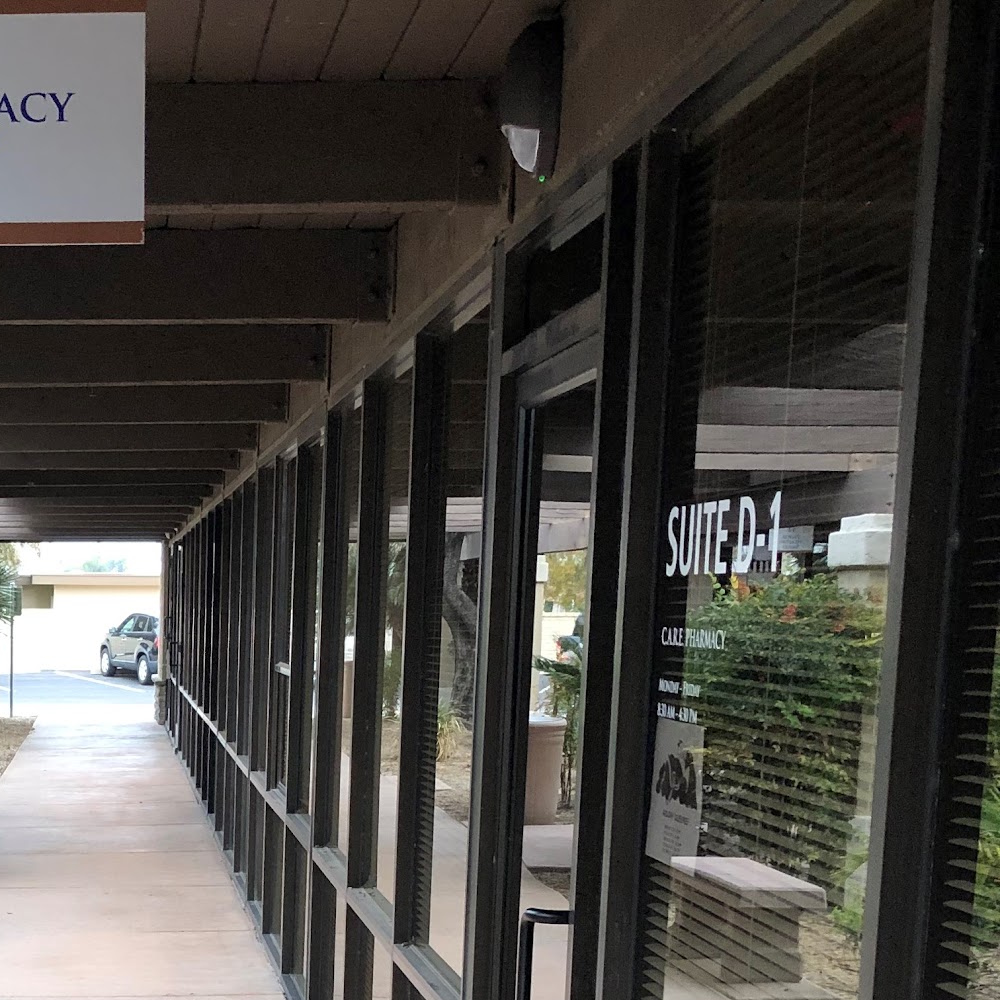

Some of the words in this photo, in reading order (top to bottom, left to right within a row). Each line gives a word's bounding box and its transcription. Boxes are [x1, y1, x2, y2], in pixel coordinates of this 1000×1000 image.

[665, 499, 731, 577] SUITE
[736, 491, 782, 573] D-1
[685, 628, 727, 650] PHARMACY
